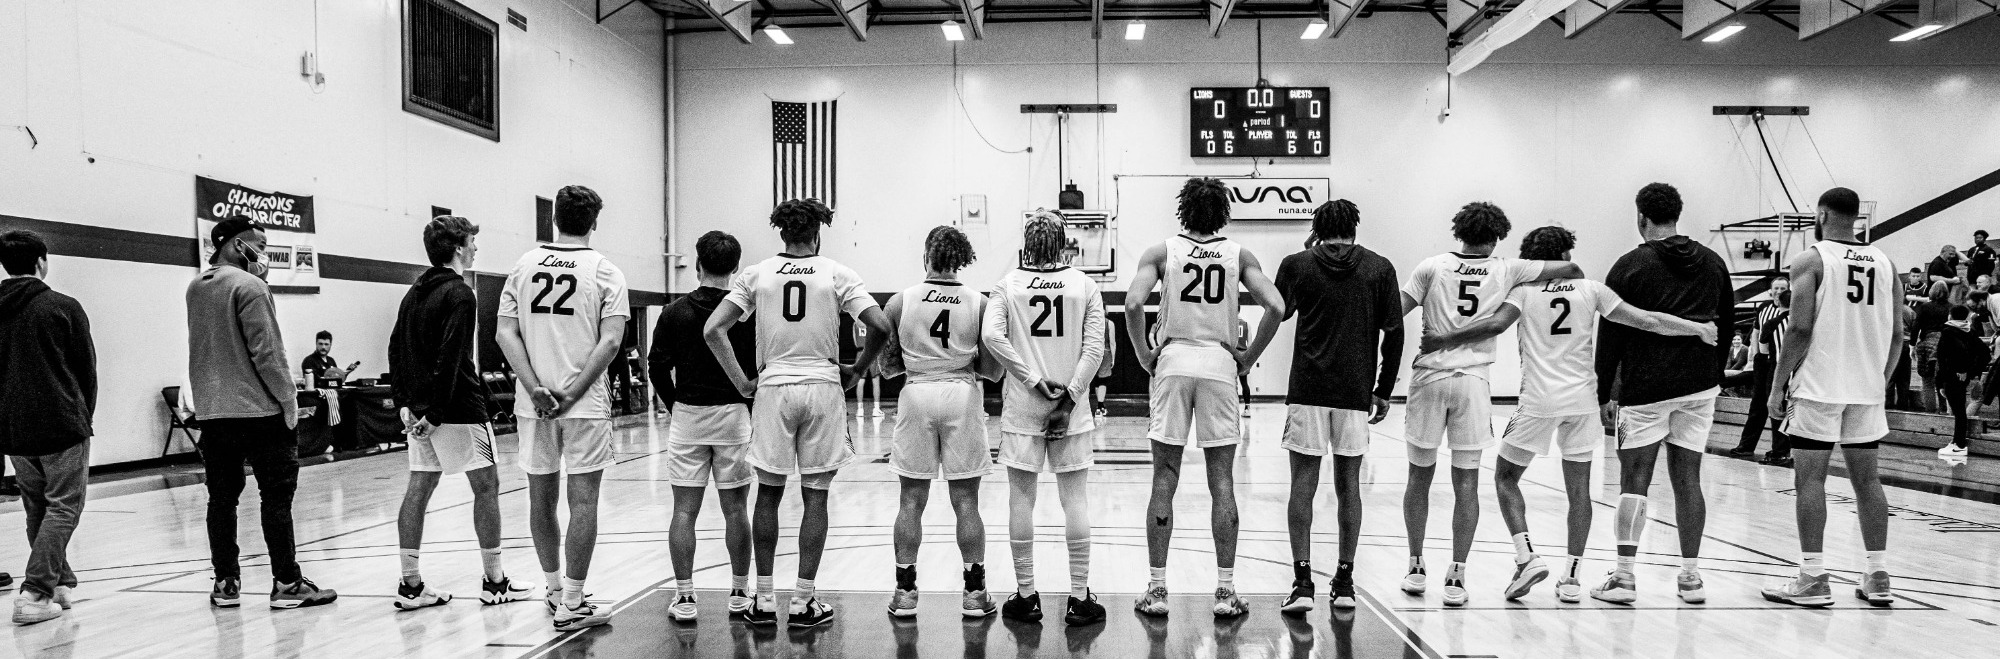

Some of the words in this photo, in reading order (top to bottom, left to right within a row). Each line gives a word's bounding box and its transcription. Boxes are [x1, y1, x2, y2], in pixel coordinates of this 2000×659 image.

[1193, 90, 1214, 99] LIONS
[1247, 89, 1273, 107] 0.0
[1289, 90, 1312, 99] GUESTS
[1214, 100, 1225, 118] 0
[1310, 100, 1320, 118] 0
[1250, 117, 1271, 126] period
[1200, 130, 1214, 139] FLS
[1222, 130, 1235, 139] TOL
[1248, 130, 1273, 139] PLAYER
[1286, 130, 1298, 139] TOL
[1308, 130, 1321, 139] FLS
[1207, 140, 1216, 154] 0
[1224, 140, 1234, 154] 6
[1287, 140, 1297, 154] 6
[1313, 140, 1322, 154] 0
[213, 202, 231, 218] OF
[233, 205, 301, 228] CHARCTER
[1187, 246, 1223, 259] Lions
[1844, 249, 1875, 263] Lions
[538, 254, 577, 269] Lions
[776, 262, 816, 275] Lions
[1454, 263, 1489, 276] Lions
[1027, 277, 1065, 290] Lions
[1180, 262, 1226, 304] 20
[1542, 281, 1575, 293] Lions
[1847, 264, 1876, 306] 51
[531, 272, 578, 316] 22
[782, 280, 807, 322] 0
[921, 289, 962, 305] Lions
[1457, 280, 1481, 317] 5
[1029, 294, 1064, 338] 21
[1550, 297, 1572, 335] 2
[929, 308, 951, 349] 4
